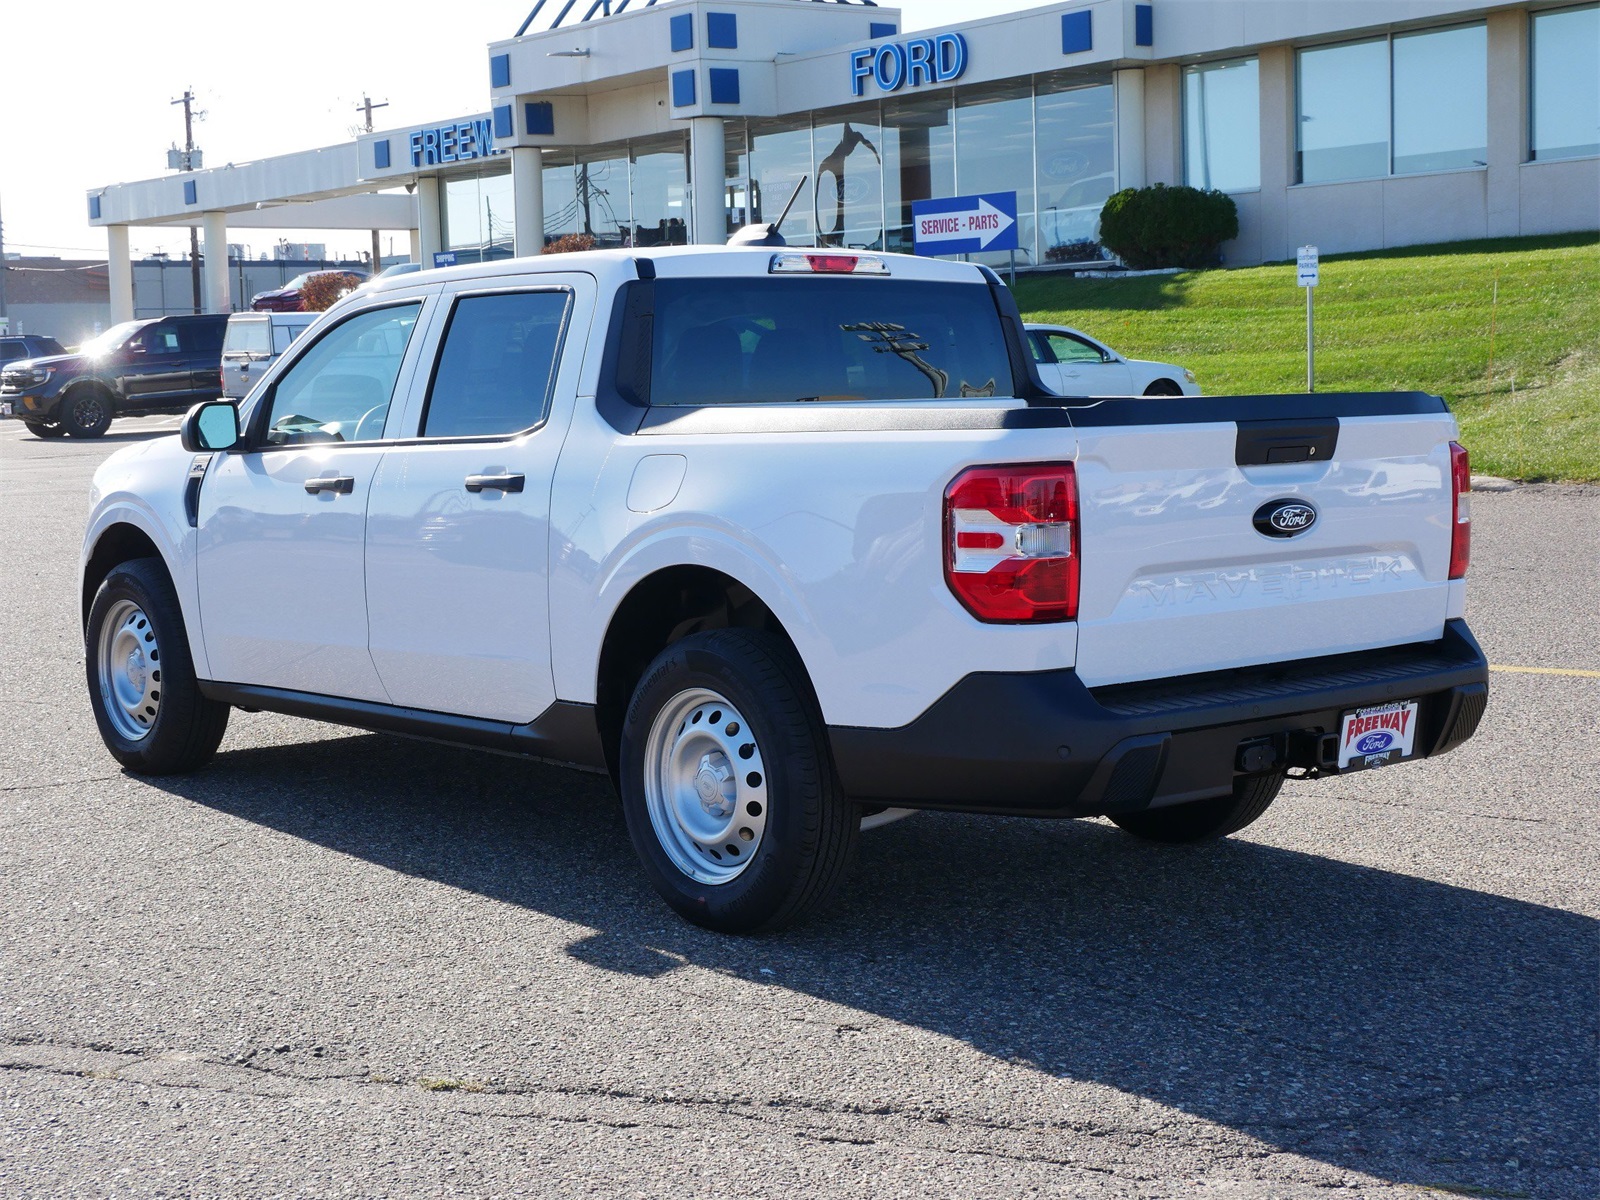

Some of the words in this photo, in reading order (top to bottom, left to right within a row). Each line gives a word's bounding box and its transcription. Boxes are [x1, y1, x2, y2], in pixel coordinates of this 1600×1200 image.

[851, 33, 968, 96] FORD
[409, 118, 505, 167] FREEW
[921, 217, 960, 235] SERVICE
[968, 213, 999, 231] PARTS
[1279, 508, 1307, 527] Ford
[1141, 556, 1404, 608] MAVERICK
[1345, 709, 1411, 750] FREEWAY
[1362, 735, 1386, 751] Ford
